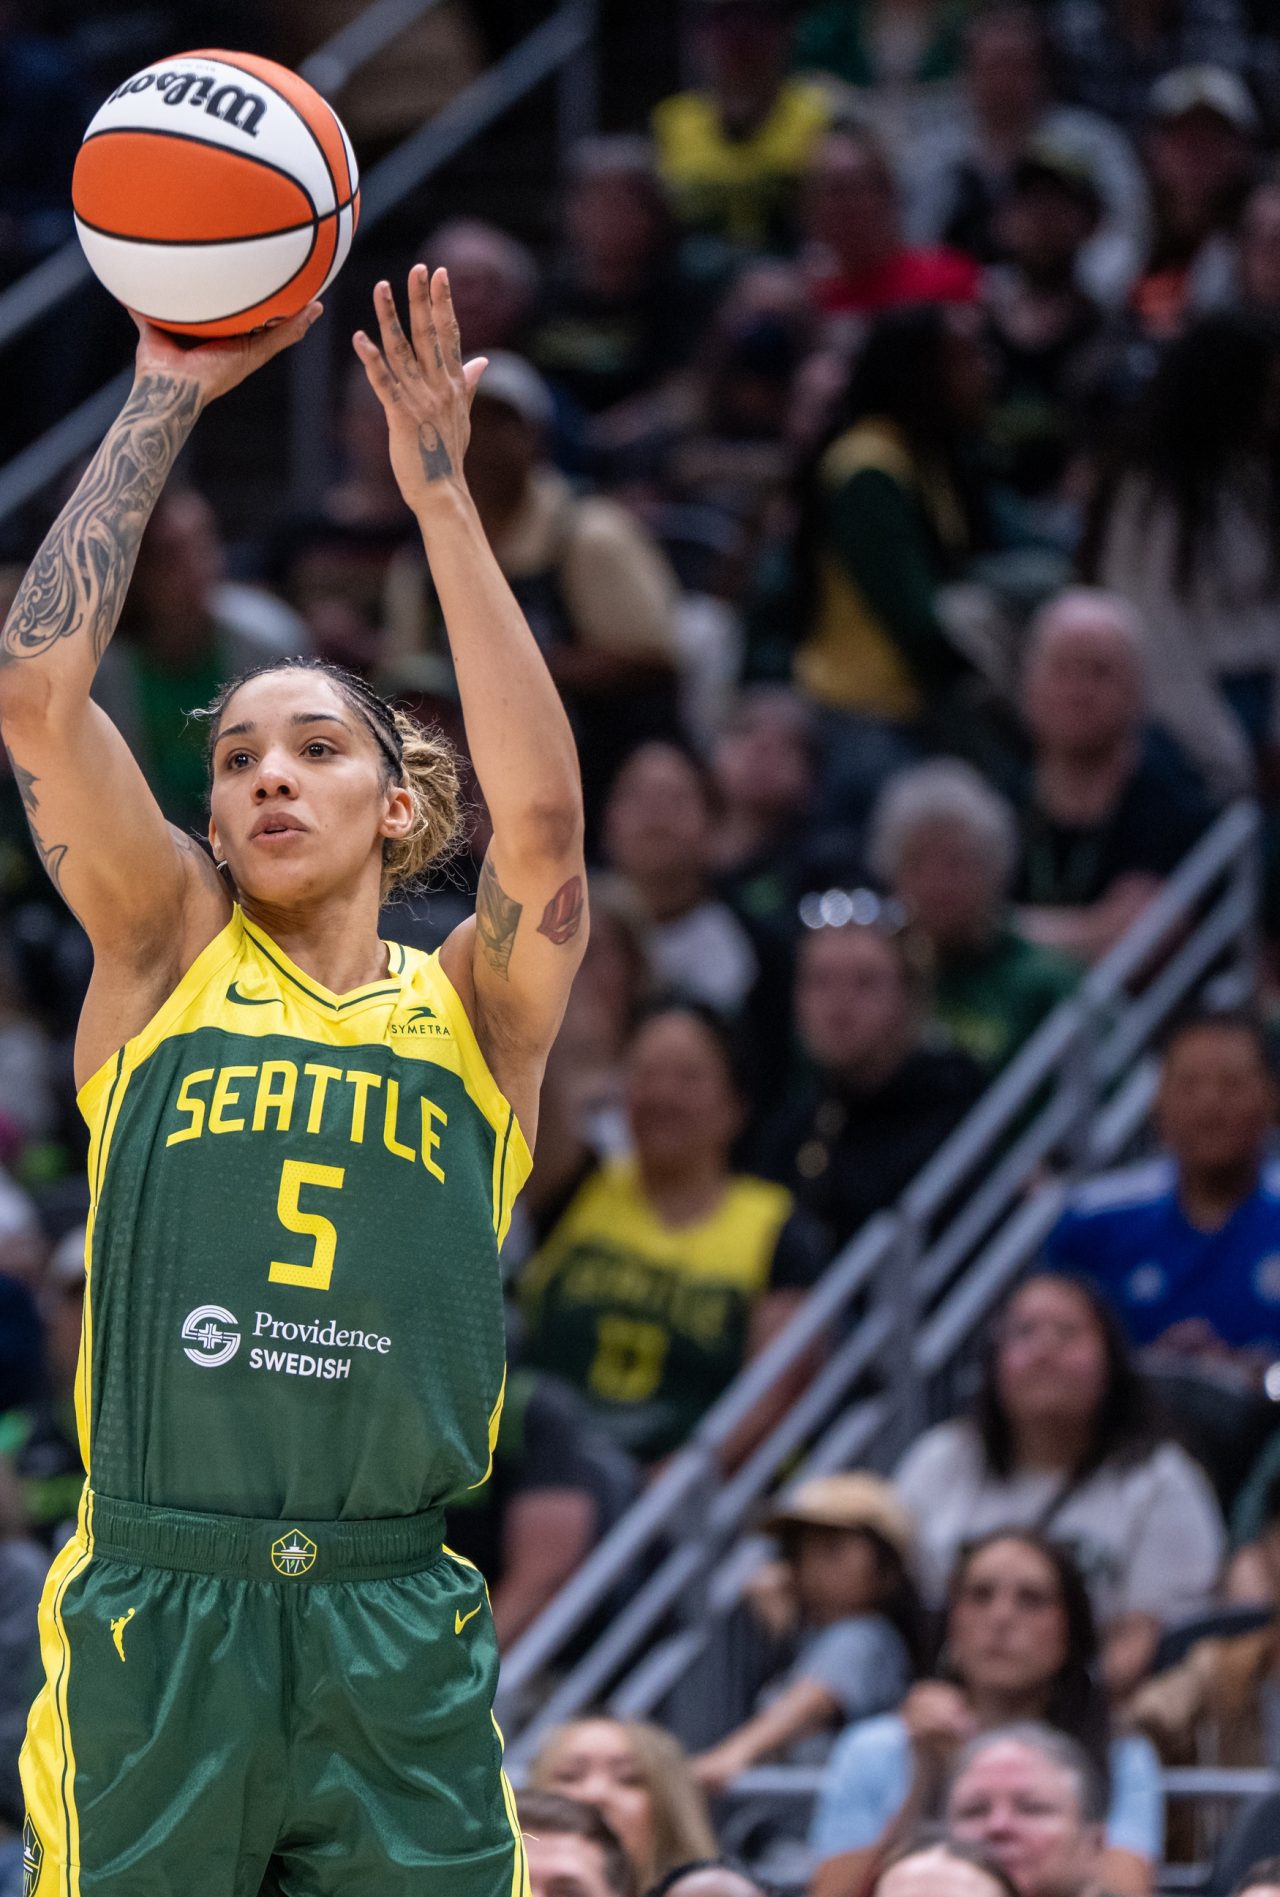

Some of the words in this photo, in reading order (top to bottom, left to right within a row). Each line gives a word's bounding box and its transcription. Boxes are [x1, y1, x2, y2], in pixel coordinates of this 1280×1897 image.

[391, 1024, 451, 1036] SYMETRA
[166, 1060, 448, 1184] SEATTLE
[267, 1159, 346, 1291] 5
[252, 1311, 392, 1354] Providence
[249, 1348, 352, 1379] SWEDISH
